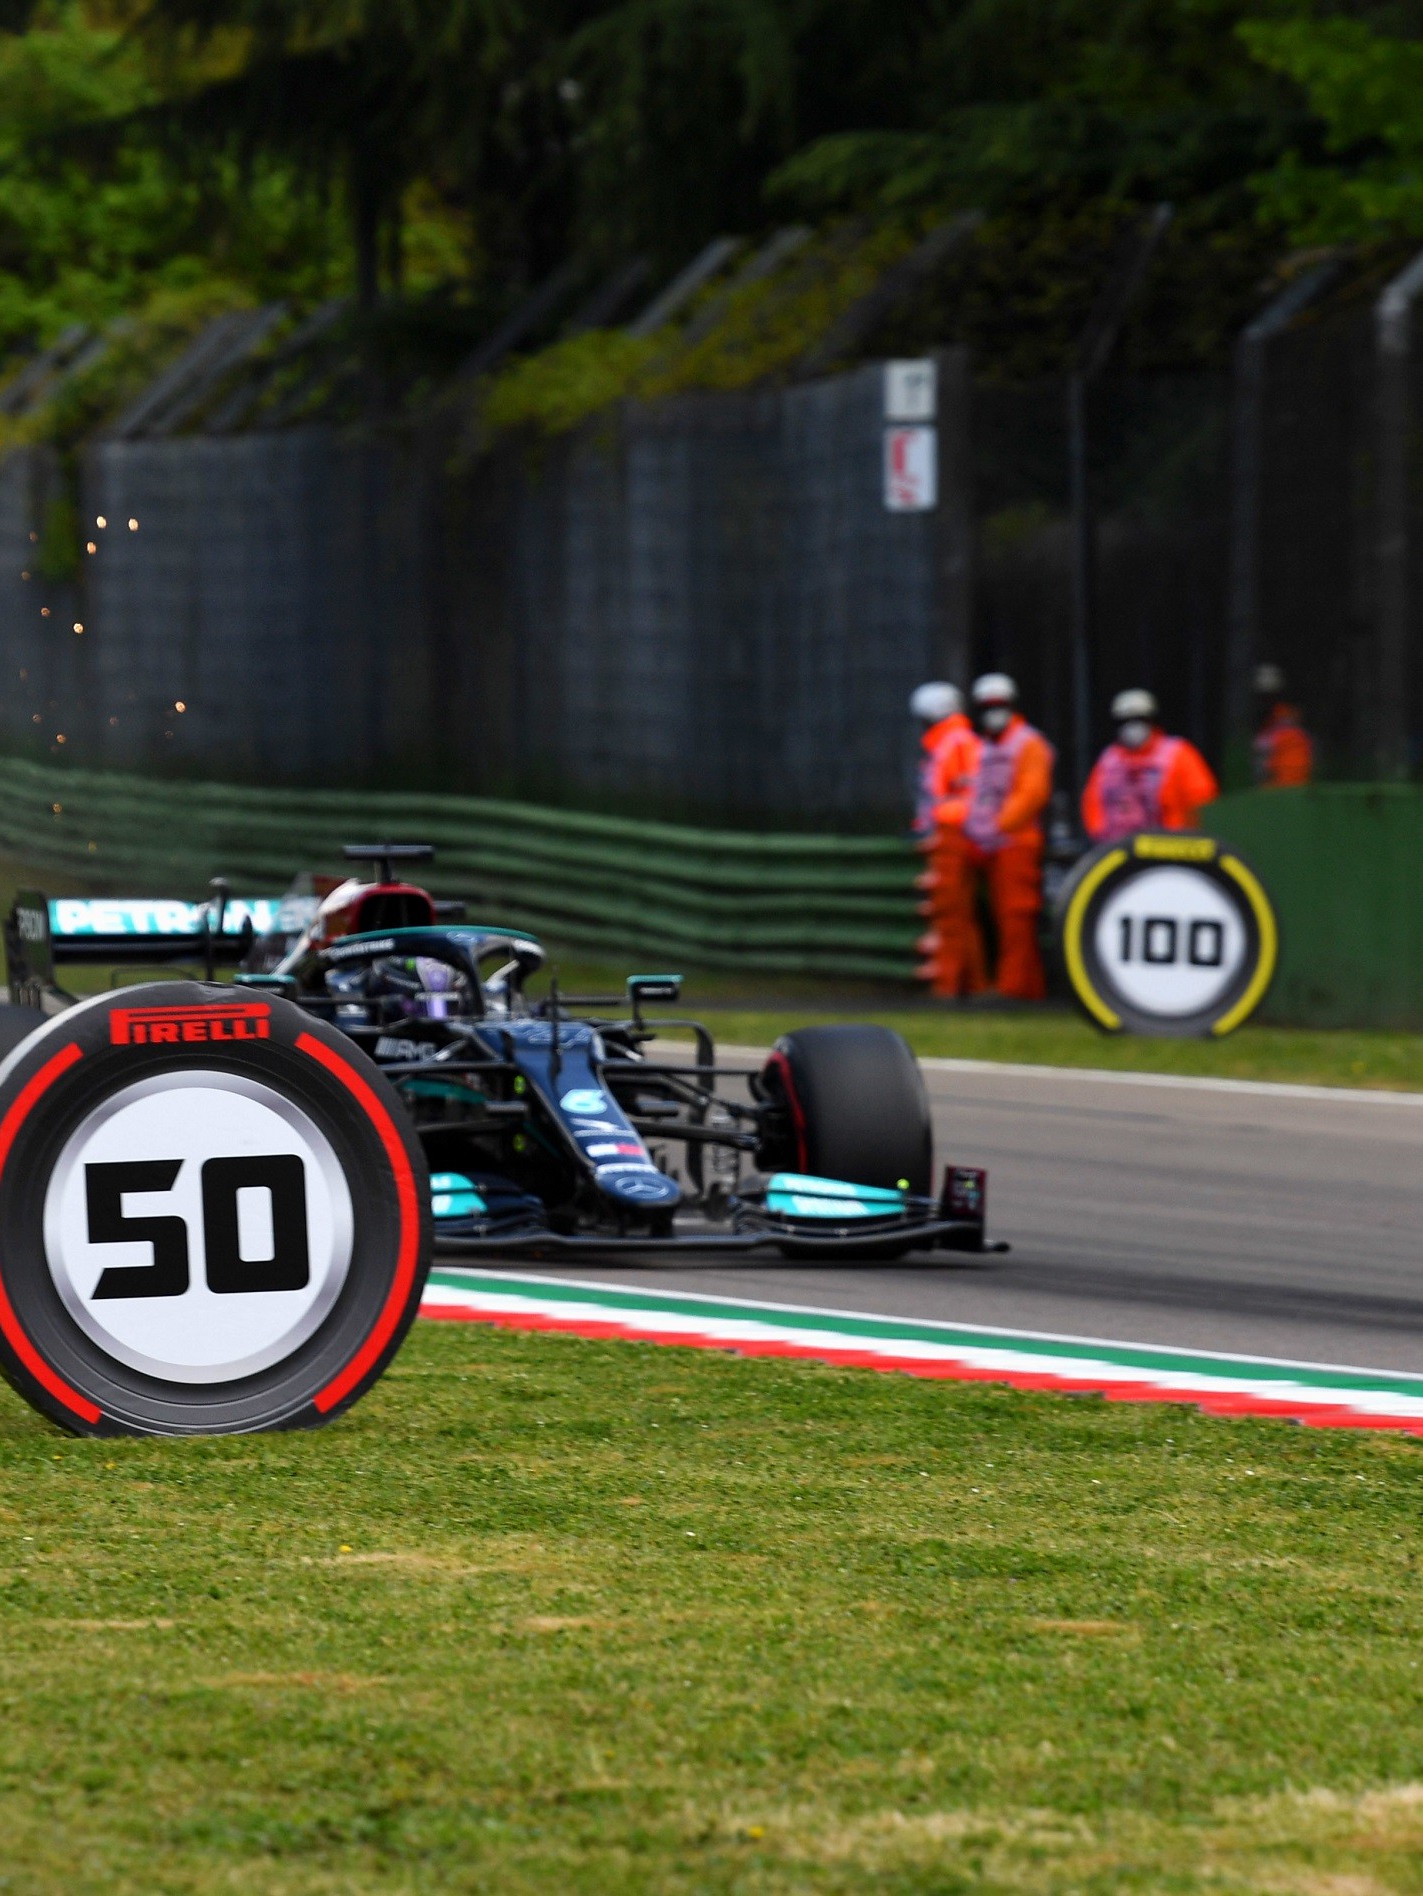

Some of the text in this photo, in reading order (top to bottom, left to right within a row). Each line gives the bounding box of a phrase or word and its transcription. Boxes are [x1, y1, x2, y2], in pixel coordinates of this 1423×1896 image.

[1120, 915, 1223, 966] 100
[110, 1003, 270, 1044] PIRELLI
[85, 1154, 310, 1300] 50
